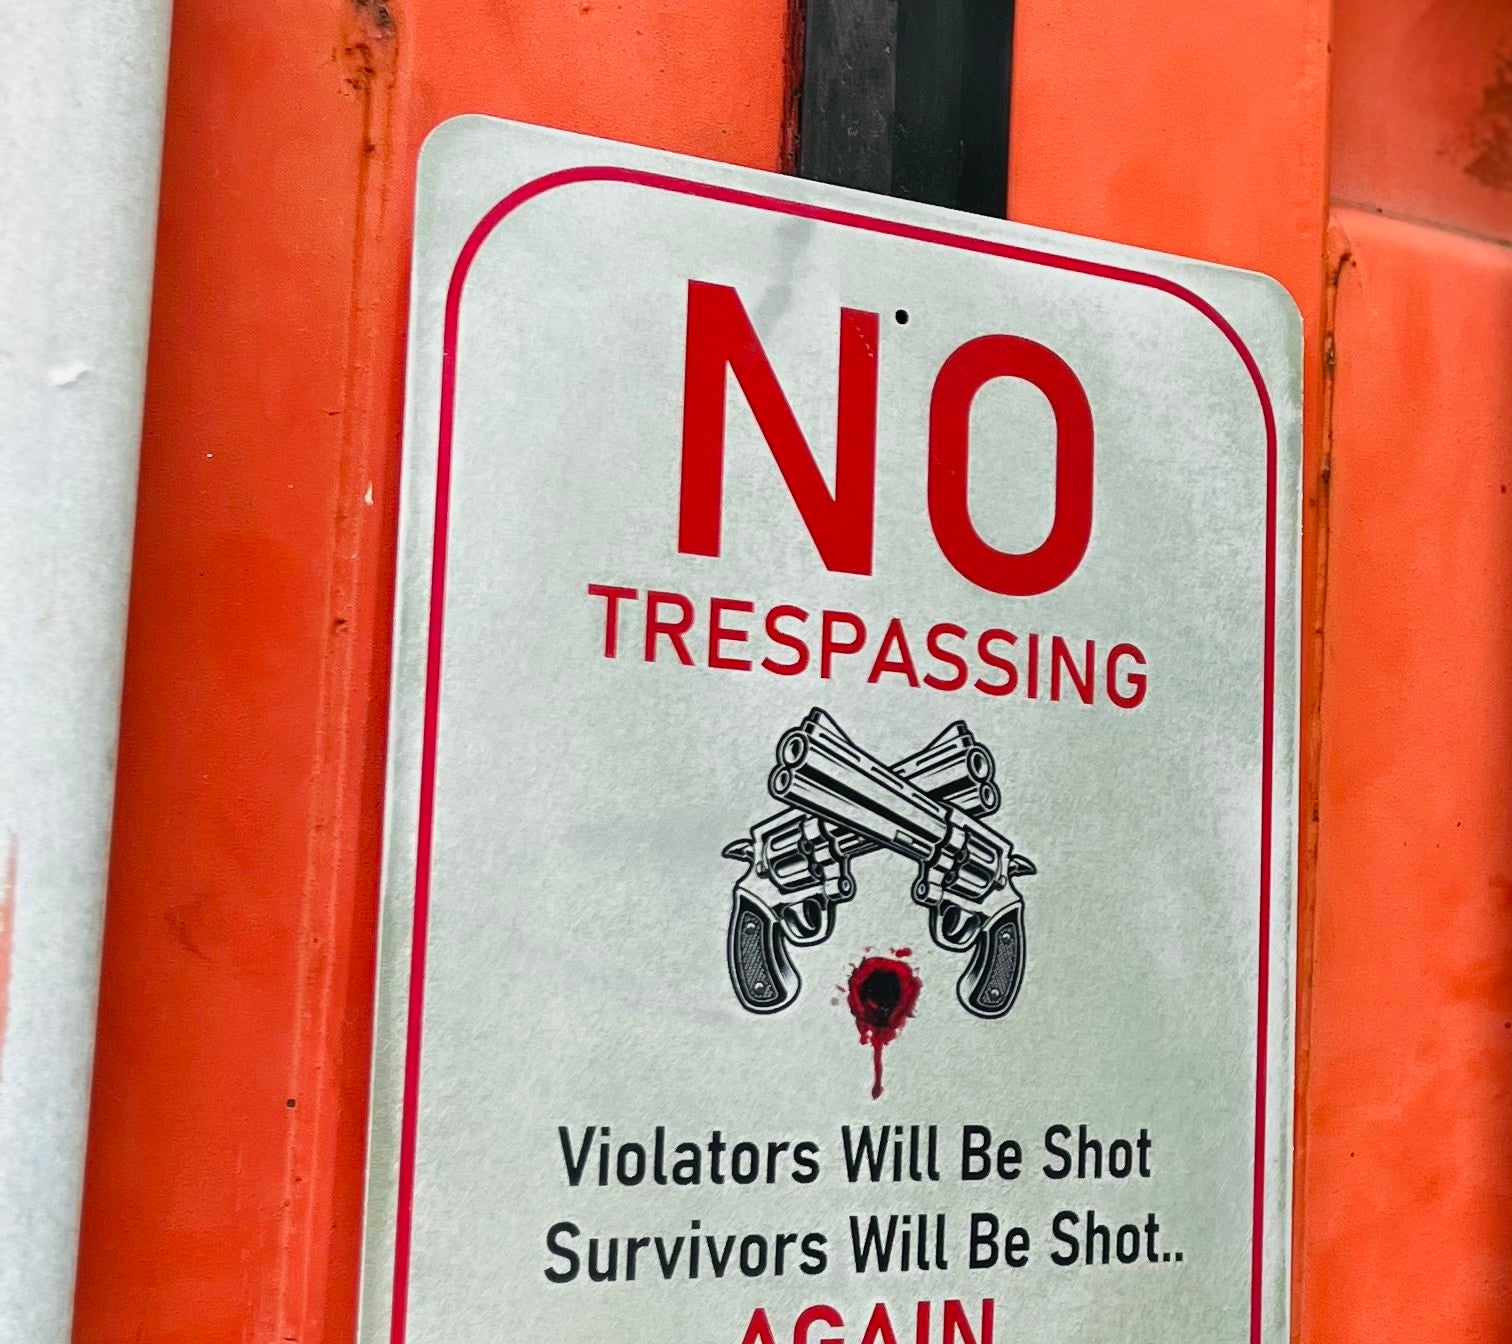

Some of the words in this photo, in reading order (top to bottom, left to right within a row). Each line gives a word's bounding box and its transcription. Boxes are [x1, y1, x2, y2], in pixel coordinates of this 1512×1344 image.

[678, 279, 1095, 597] NO
[588, 582, 1149, 711] TRESPASSING
[557, 1126, 821, 1187] Violators
[841, 1125, 941, 1183] Will
[960, 1124, 1023, 1181] Be
[1042, 1124, 1153, 1180] Shot
[543, 1219, 829, 1284] Survivors
[849, 1213, 949, 1273] Will
[968, 1212, 1031, 1270] Be
[1050, 1209, 1184, 1267] Shot..
